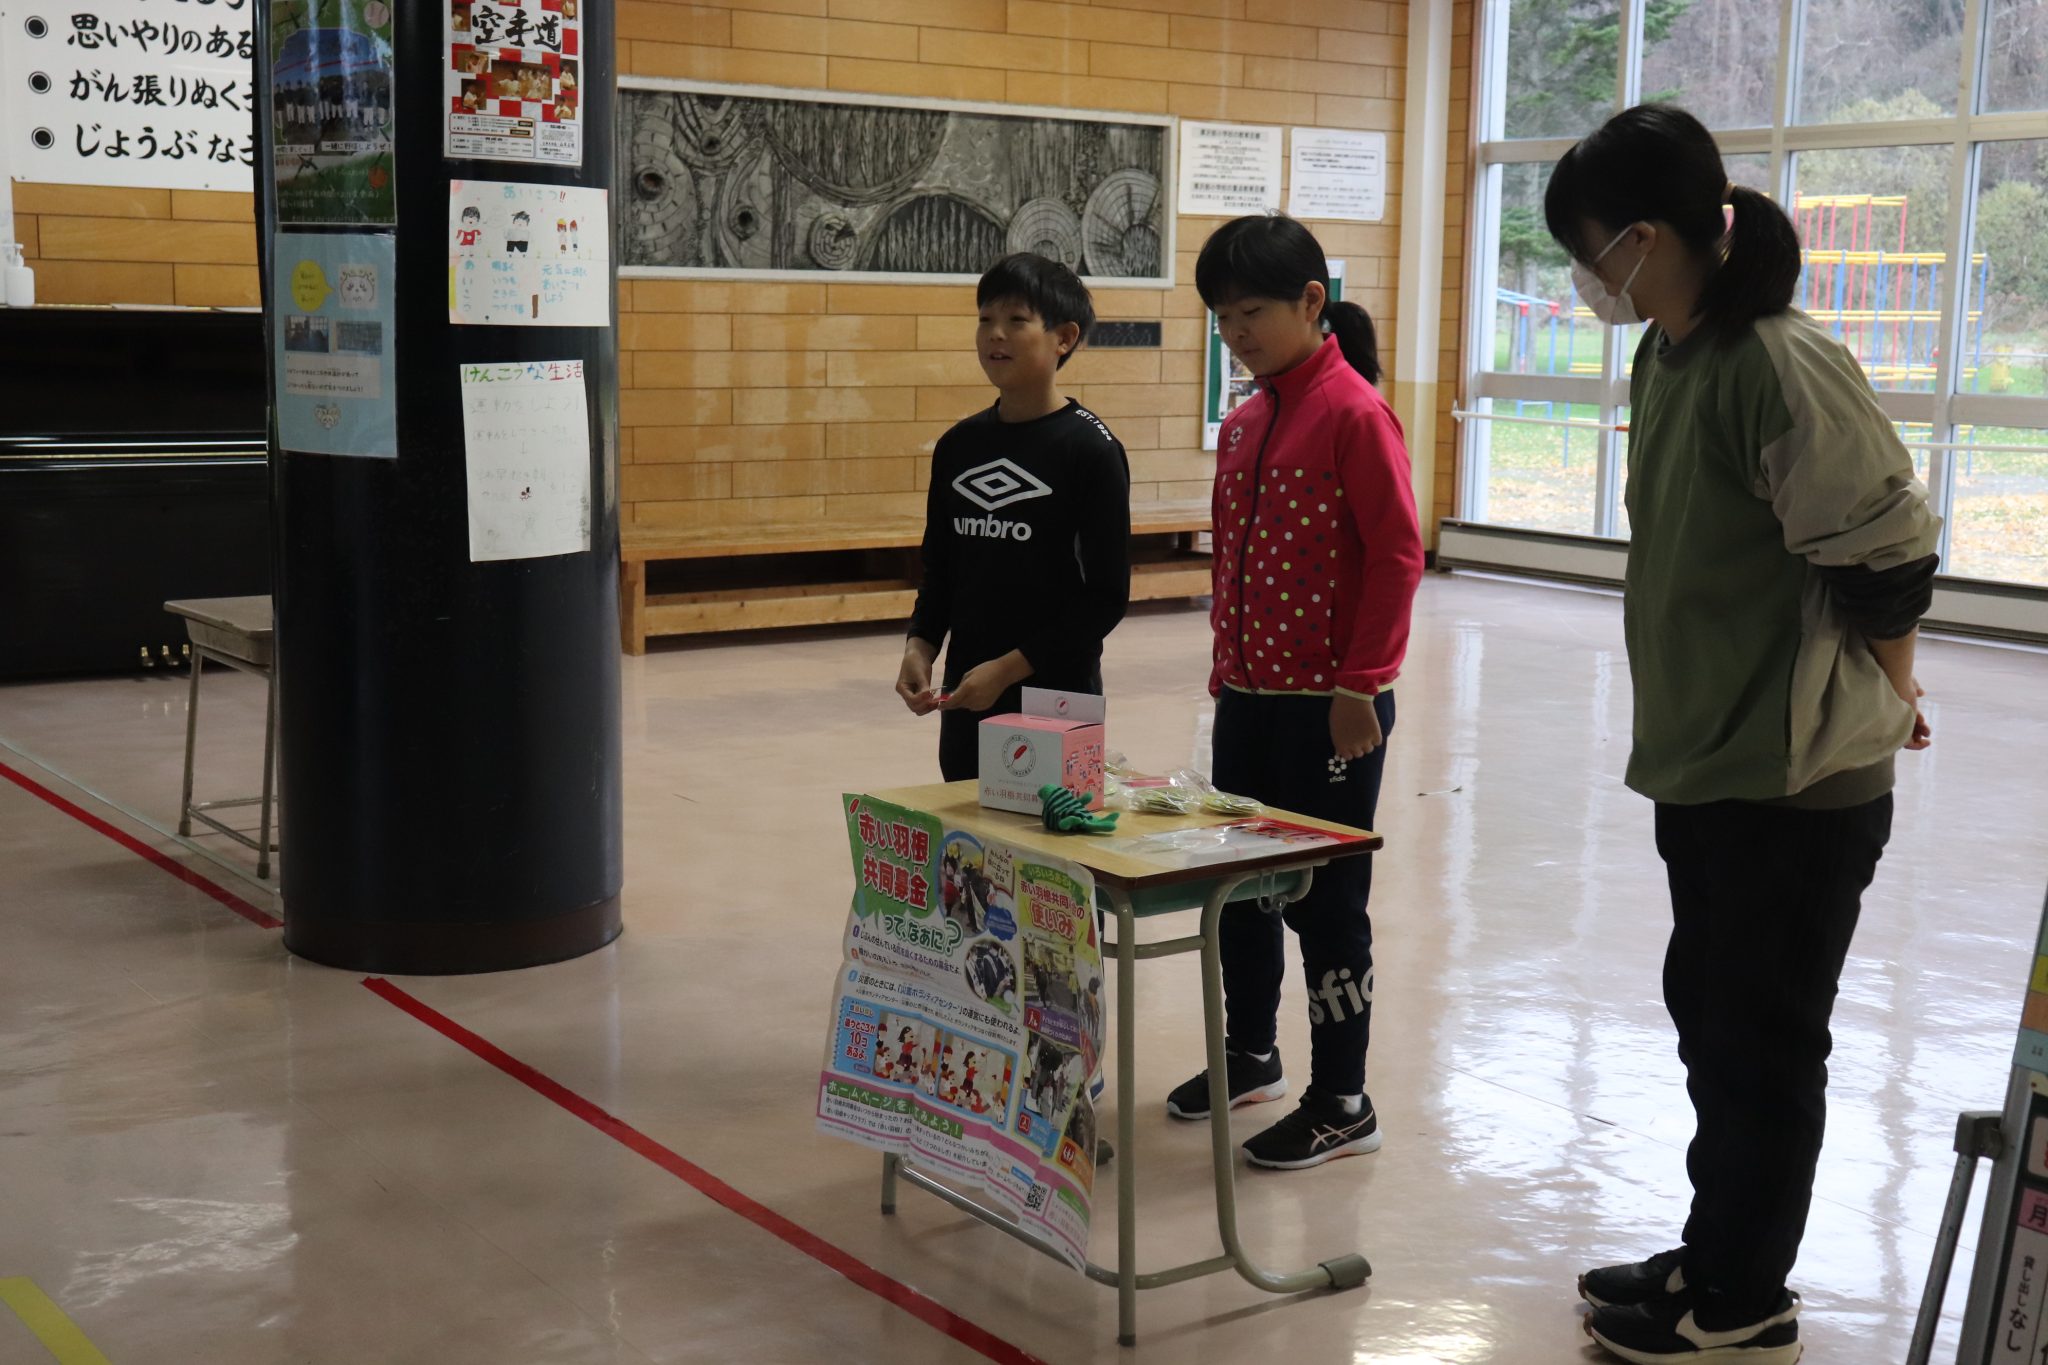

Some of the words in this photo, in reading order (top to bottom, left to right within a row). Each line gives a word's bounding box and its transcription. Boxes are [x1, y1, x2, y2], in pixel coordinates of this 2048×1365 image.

[67, 13, 253, 59] 思いやりのある
[472, 5, 562, 52] 空手道
[463, 362, 583, 383] けんこうな生活
[1075, 409, 1113, 442] EST.1924
[953, 513, 1033, 542] umbro
[859, 811, 930, 867] 赤い羽根
[862, 854, 929, 910] 共同募金
[1020, 880, 1085, 920] 赤い羽根共同の
[827, 1079, 961, 1136] ホームページをてみよう!
[2028, 1205, 2048, 1228] 月
[2006, 1255, 2036, 1352] 貸し出しなし
